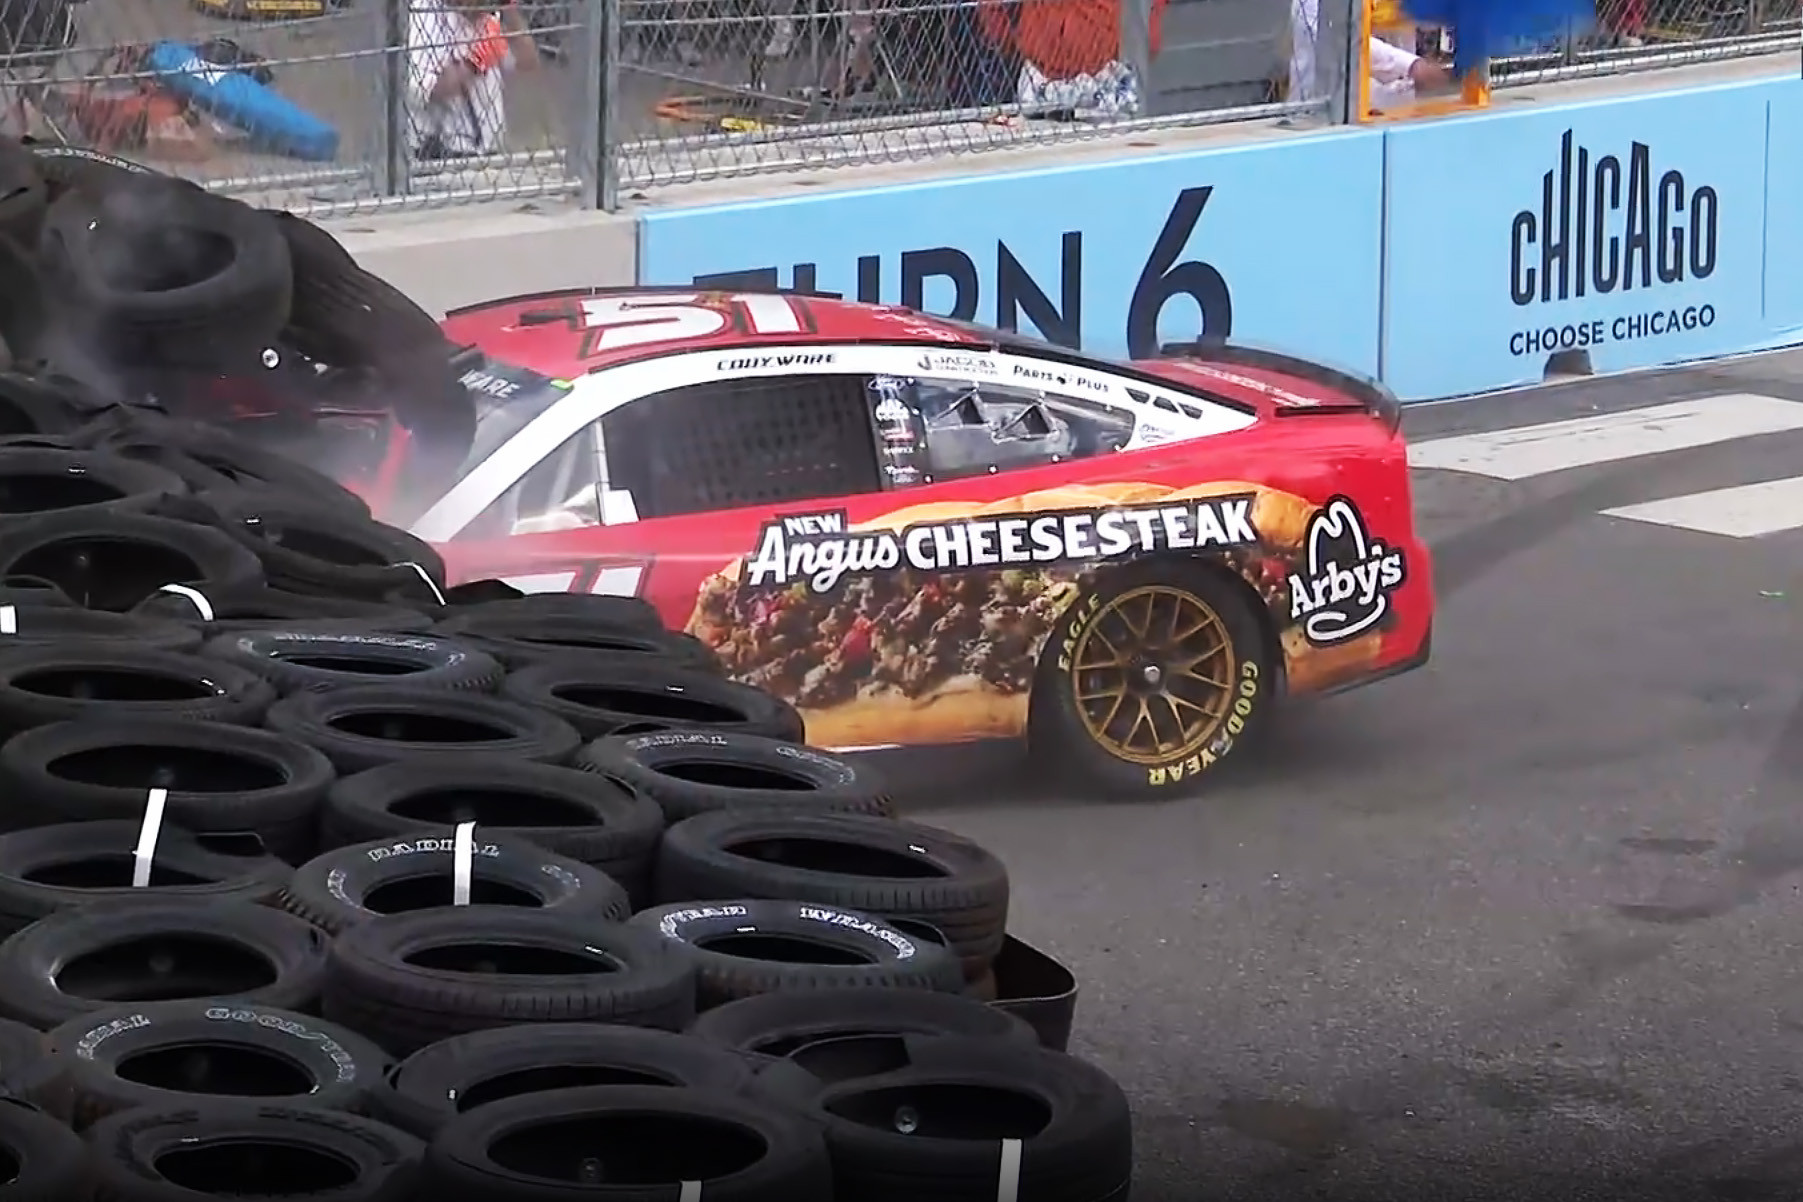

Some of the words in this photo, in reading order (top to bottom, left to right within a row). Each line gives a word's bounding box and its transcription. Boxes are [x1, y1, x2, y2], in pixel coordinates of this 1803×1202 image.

[1511, 128, 1718, 306] CHICAGO
[1127, 185, 1232, 359] 6
[581, 294, 804, 351] 51
[1509, 321, 1605, 356] CHOOSE
[1612, 304, 1716, 342] CHICAGO
[748, 526, 899, 594] Angus
[906, 499, 1257, 570] CHEESESTEAK
[784, 513, 842, 536] NEW
[1288, 544, 1403, 619] Arby's
[1058, 593, 1100, 672] EAGLE
